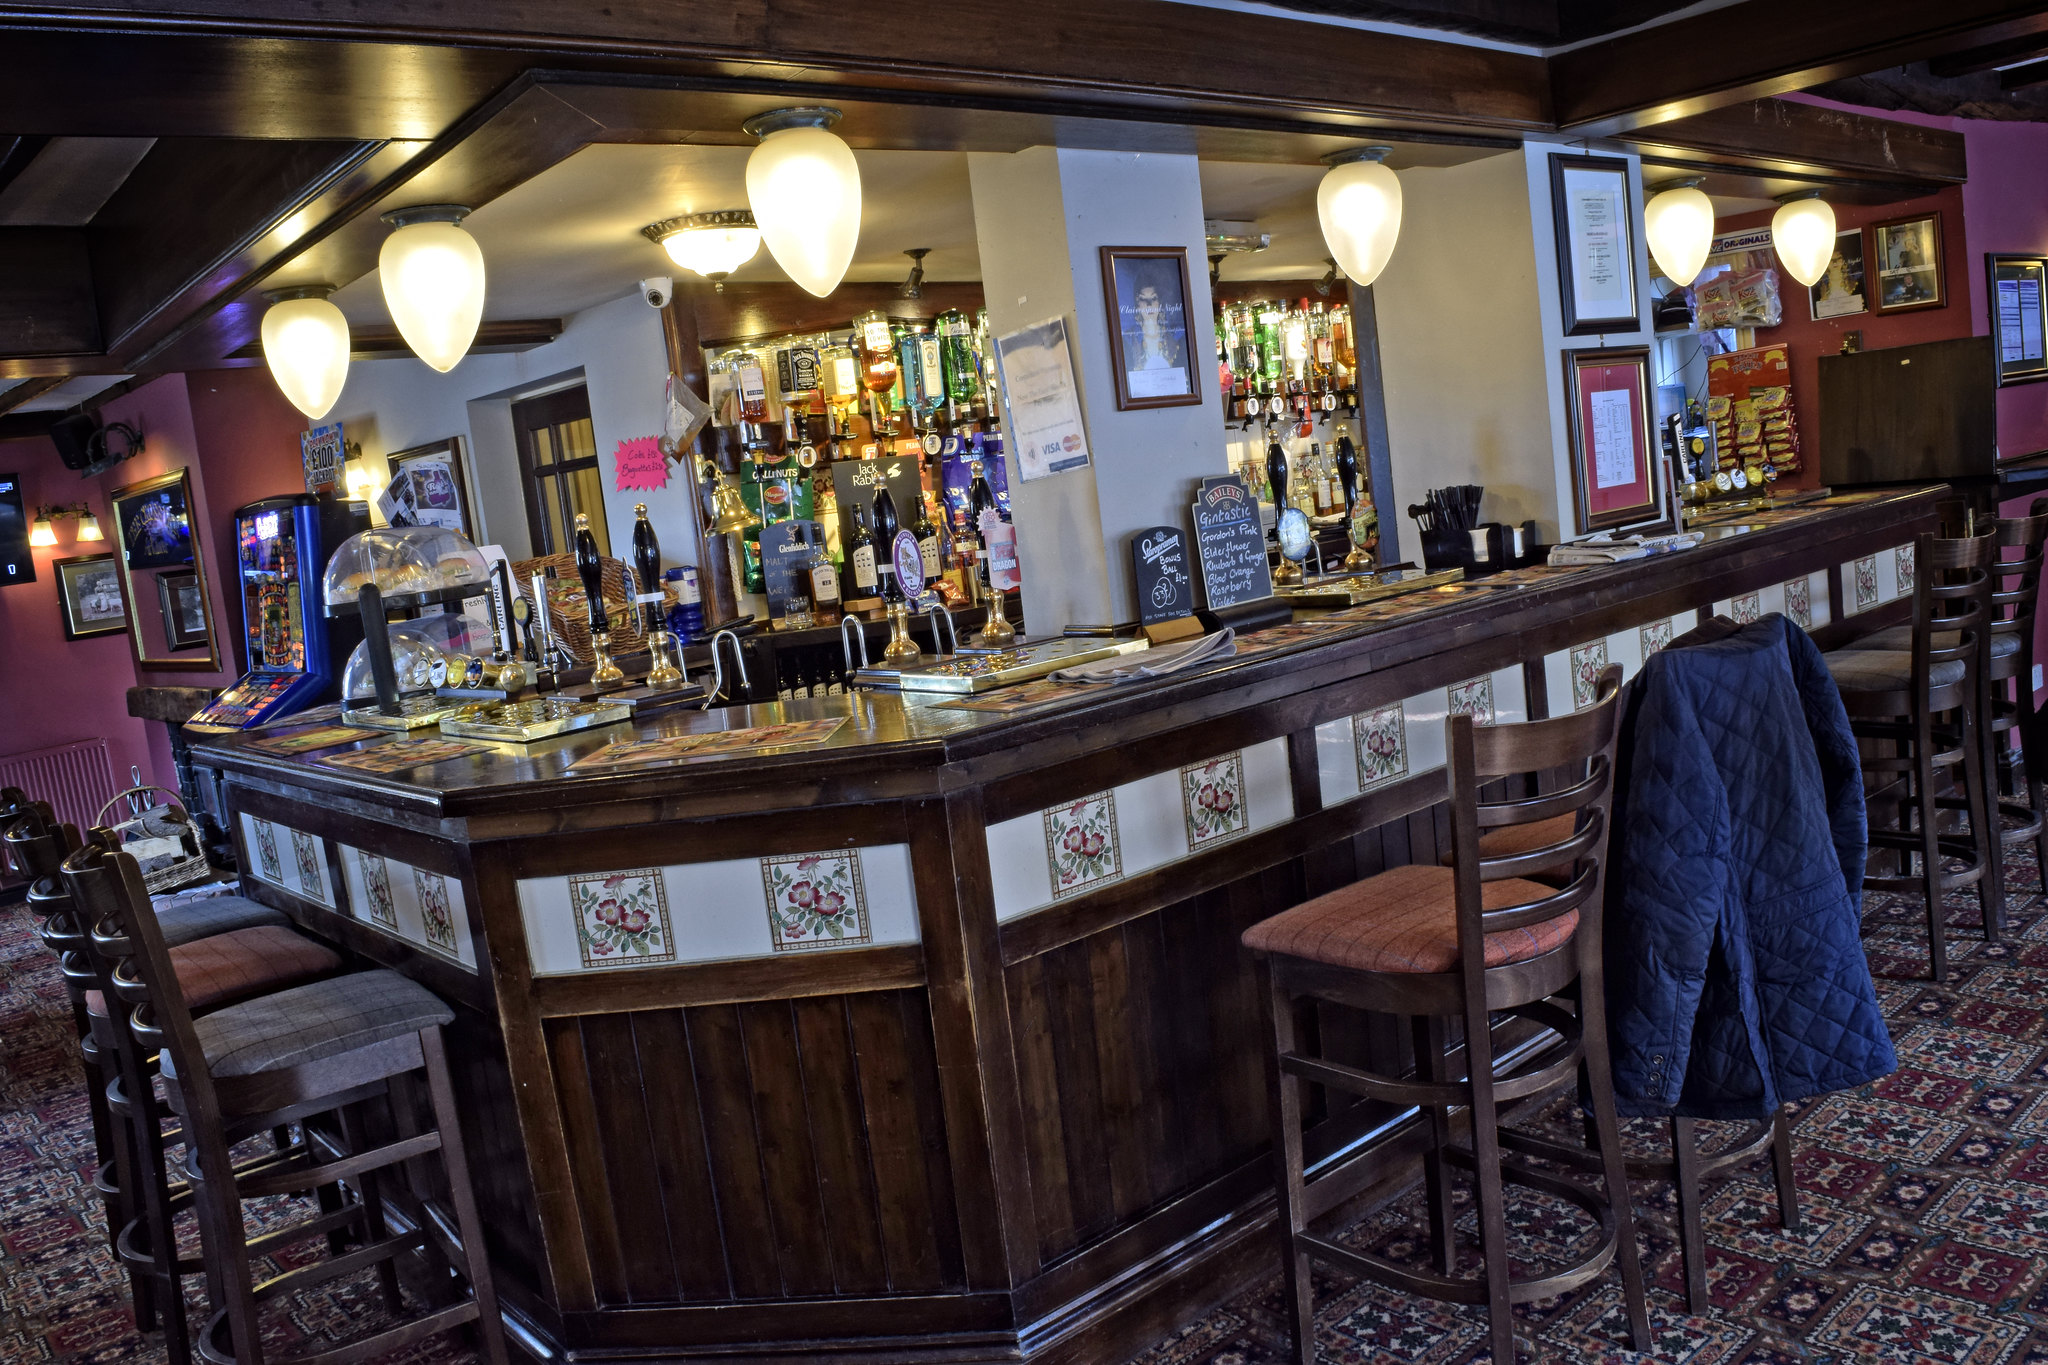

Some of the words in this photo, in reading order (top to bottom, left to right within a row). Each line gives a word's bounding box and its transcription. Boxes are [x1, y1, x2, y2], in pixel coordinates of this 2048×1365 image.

[1724, 234, 1770, 248] ORIGINALS
[1162, 303, 1183, 315] Night
[1041, 442, 1061, 456] VISA
[1677, 429, 1687, 464] CARLING
[311, 445, 333, 470] £100
[313, 468, 335, 484] JACKPOT
[752, 470, 775, 481] CLLI
[776, 468, 798, 478] NUTS
[858, 462, 878, 478] Jack
[1208, 487, 1241, 503] BAILEYS
[1200, 502, 1251, 527] Gintastic
[1201, 527, 1235, 545] Gordon's
[1239, 523, 1258, 536] Pink
[779, 541, 810, 554] Glenfiddich
[1142, 534, 1180, 560] Staropramen
[1203, 541, 1251, 559] Elderflower
[992, 558, 1016, 571] DRAGON
[1159, 553, 1181, 565] BONUS
[1206, 556, 1236, 572] Rhubarb
[1245, 550, 1266, 566] Ginger
[1161, 564, 1178, 575] BALL
[1211, 579, 1252, 597] Raspberry
[464, 597, 487, 608] reshl
[492, 583, 505, 630] CARLING
